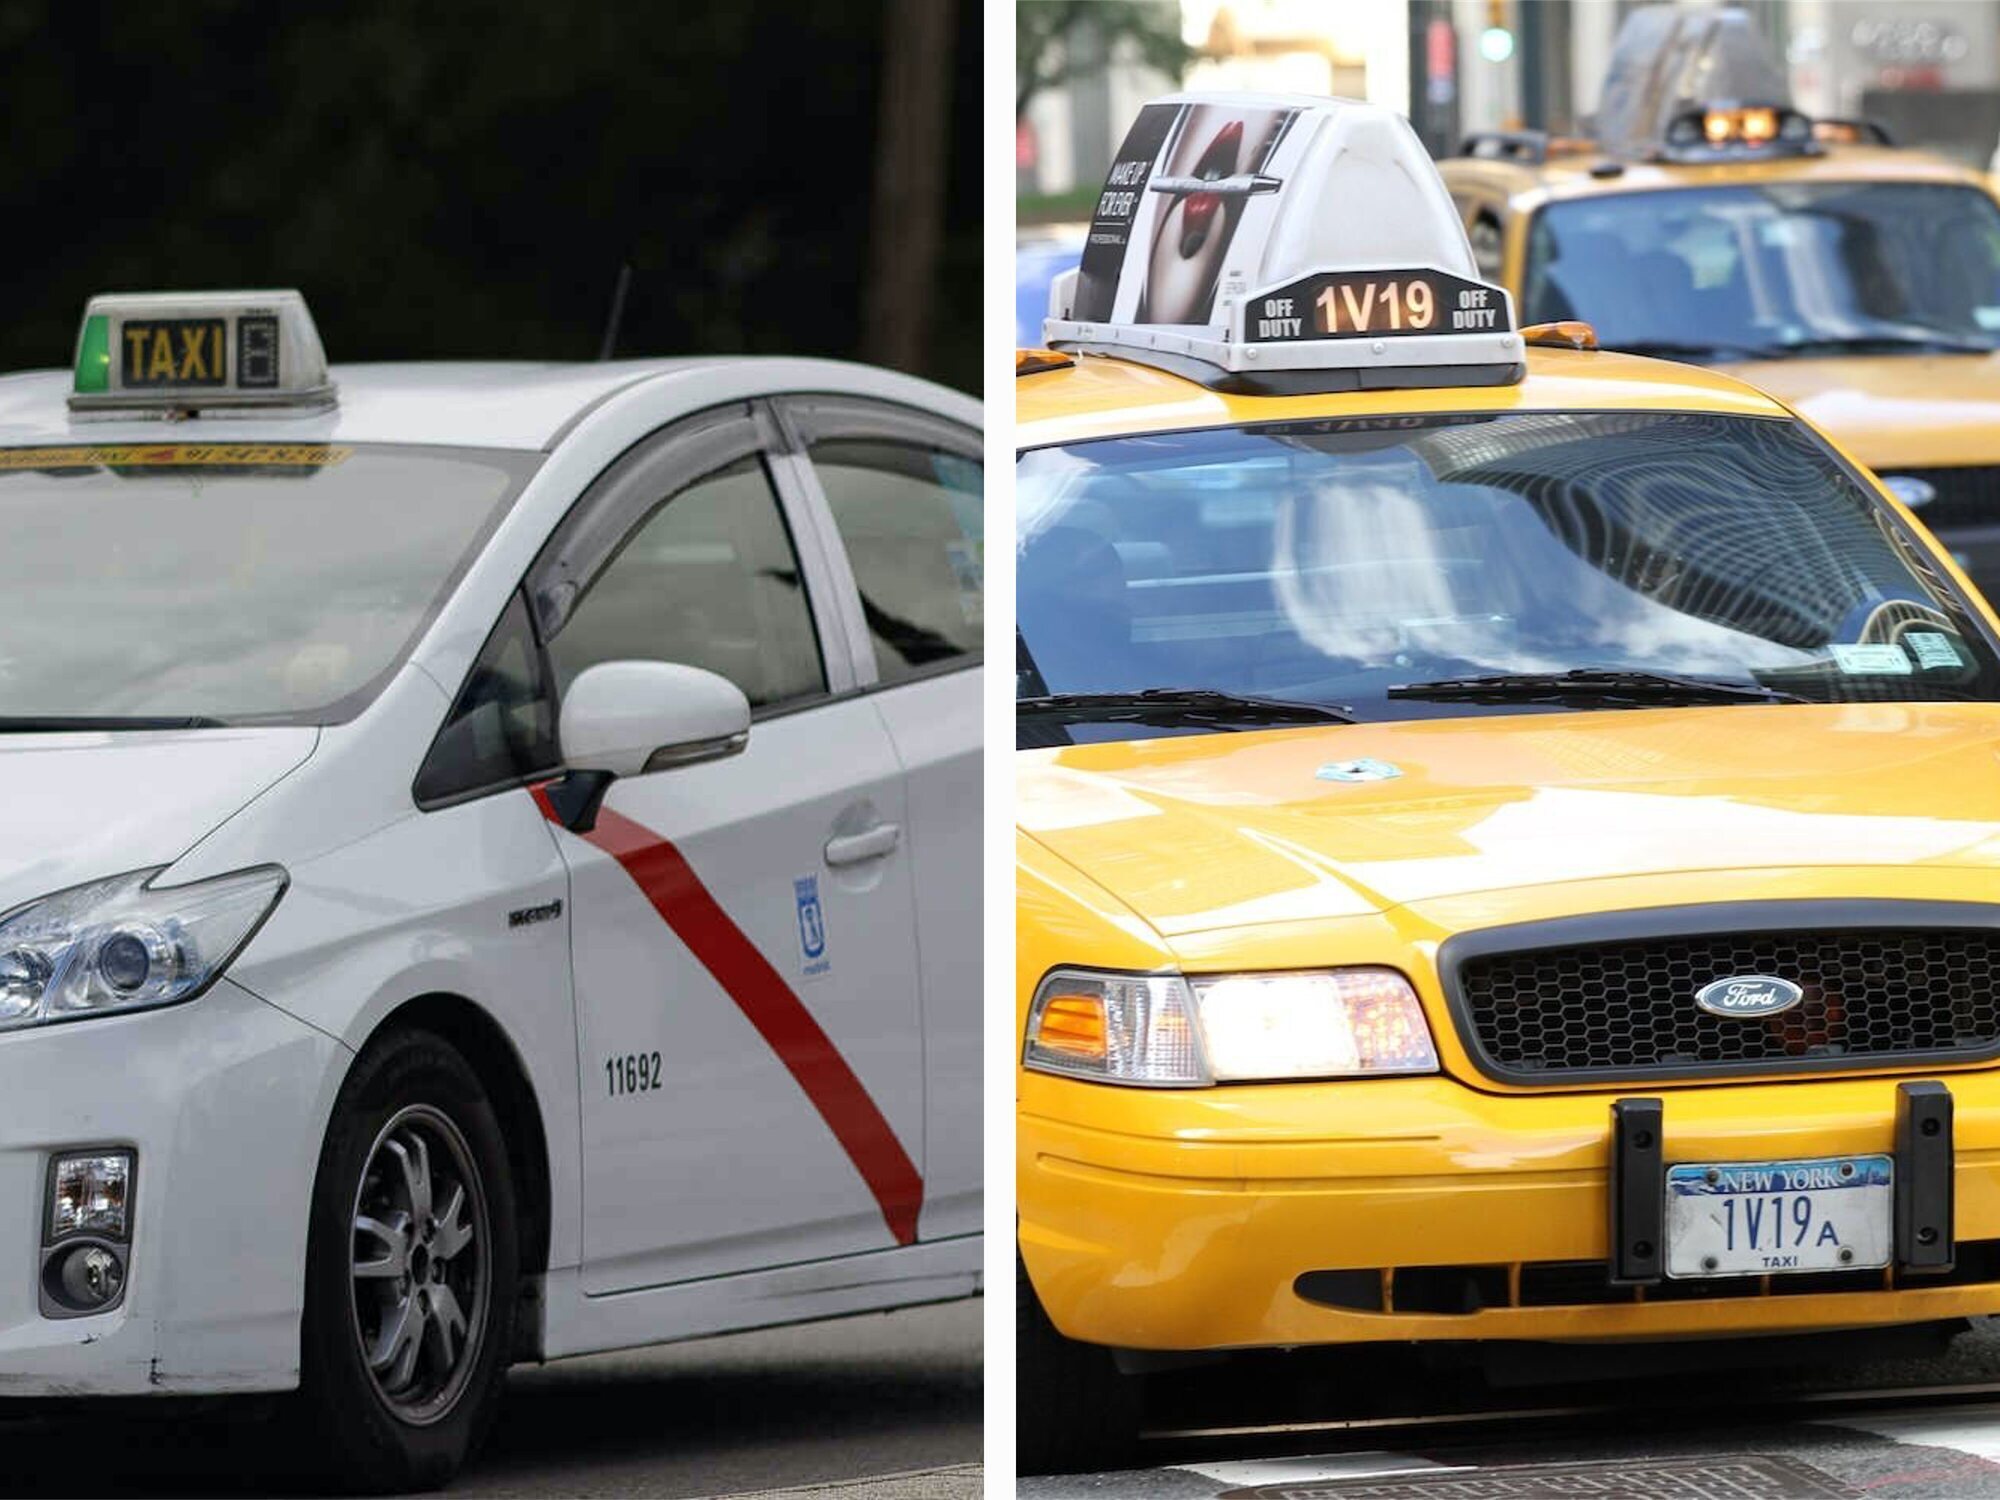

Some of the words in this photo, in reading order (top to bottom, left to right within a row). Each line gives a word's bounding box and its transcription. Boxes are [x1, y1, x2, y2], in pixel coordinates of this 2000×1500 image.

[1264, 298, 1295, 318] OFF
[1316, 279, 1435, 334] 1V19
[1458, 289, 1489, 309] OFF
[1258, 318, 1303, 338] DUTY
[1452, 309, 1497, 329] DUTY
[126, 326, 224, 381] TAXI
[1722, 982, 1777, 1008] Ford
[605, 1051, 662, 1097] 11692
[1723, 1171, 1776, 1193] NEW
[1781, 1167, 1838, 1191] YORK
[1762, 1256, 1798, 1268] TAXI
